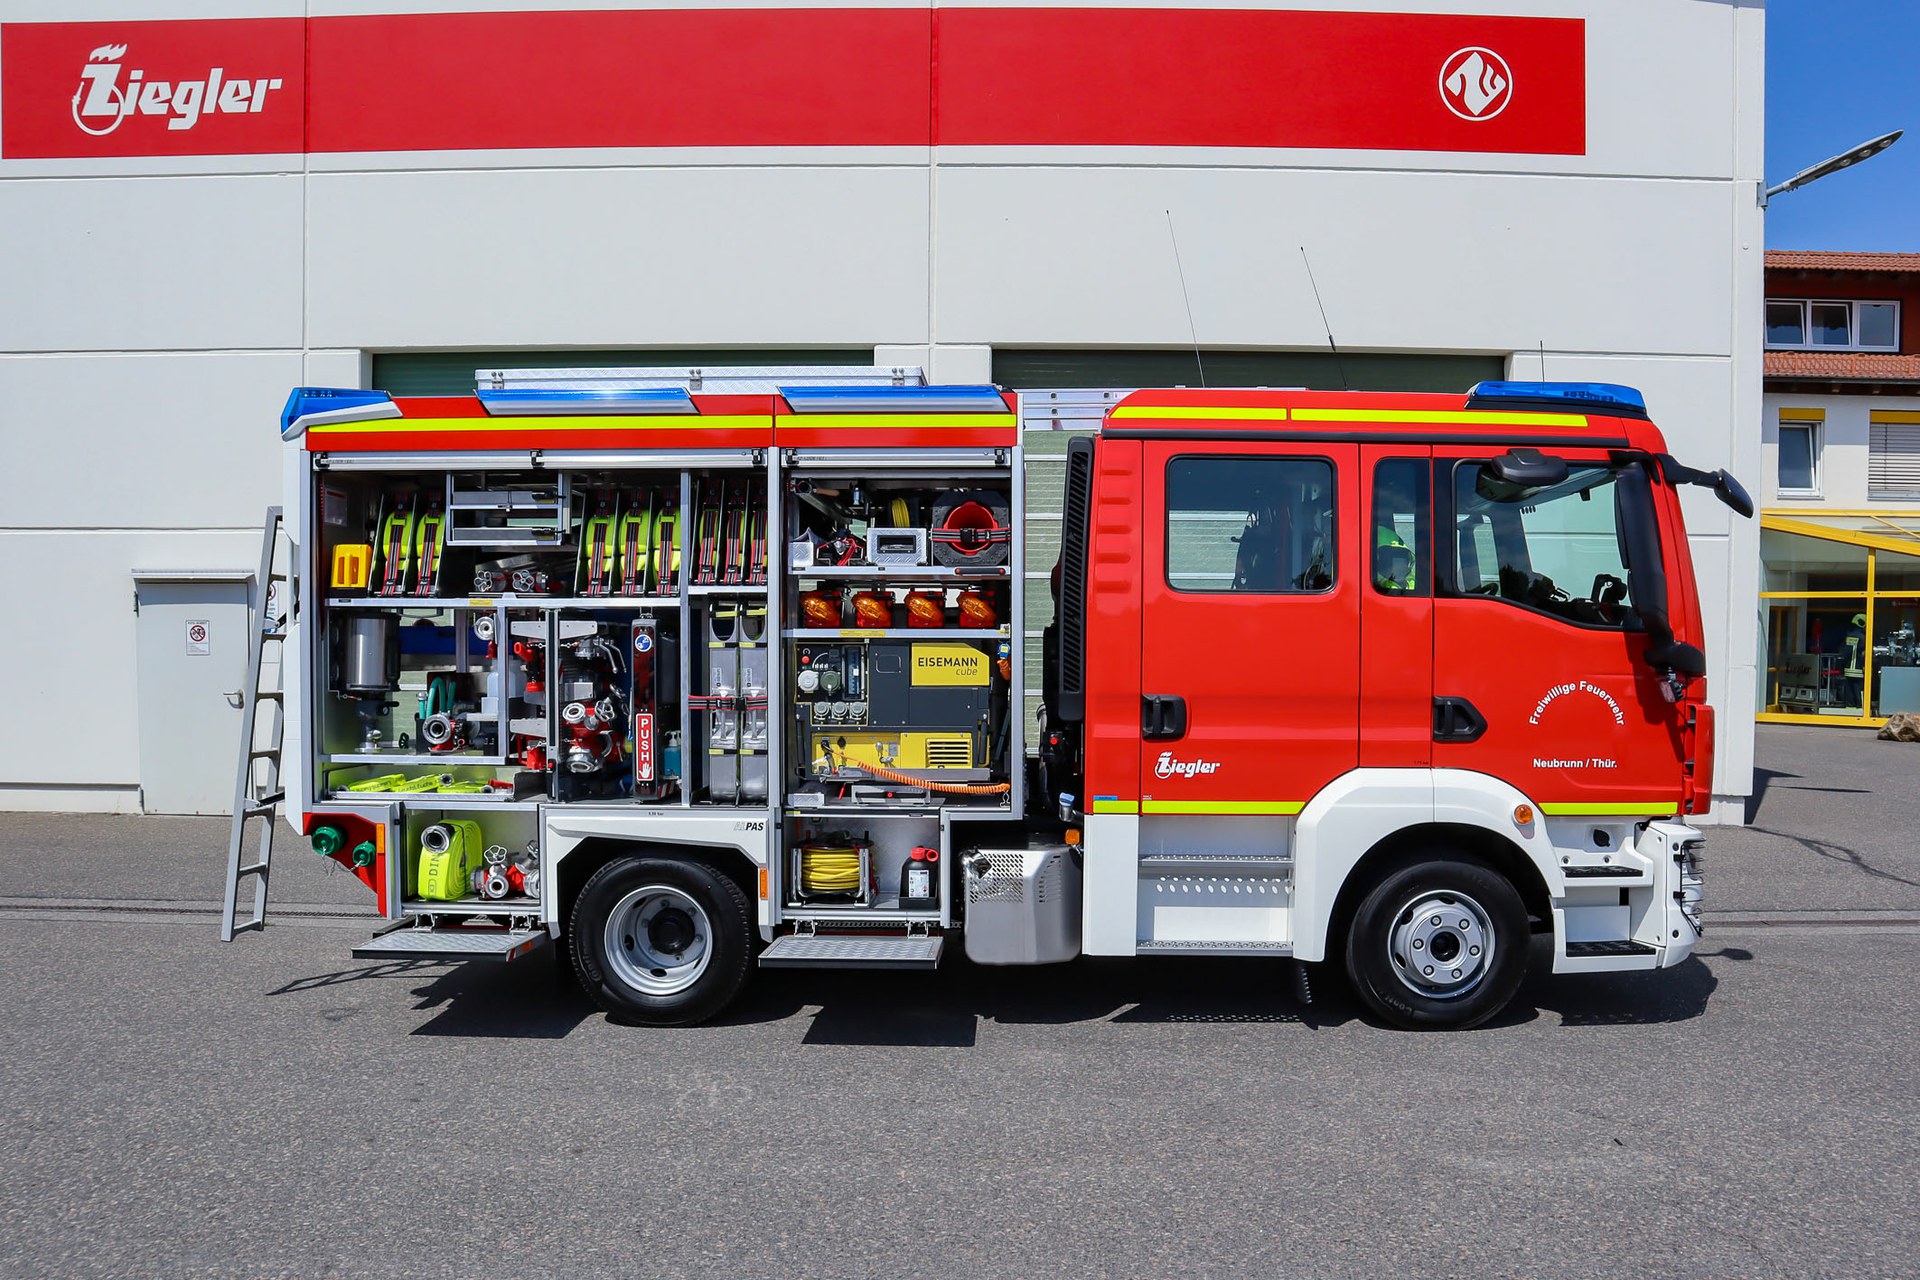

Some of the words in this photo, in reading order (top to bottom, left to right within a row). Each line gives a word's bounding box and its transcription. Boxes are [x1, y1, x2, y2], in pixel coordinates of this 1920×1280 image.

[76, 60, 283, 132] Ziegler
[917, 656, 979, 667] EISEMANN
[955, 667, 979, 676] cube
[1529, 683, 1576, 725] Freiwillige
[1579, 680, 1624, 725] Feuerwehr
[640, 717, 650, 762] PUSH
[1155, 755, 1221, 779] Ziegler
[1533, 758, 1583, 768] Neubrunn
[1585, 758, 1590, 768] /
[1591, 758, 1618, 768] Thür.
